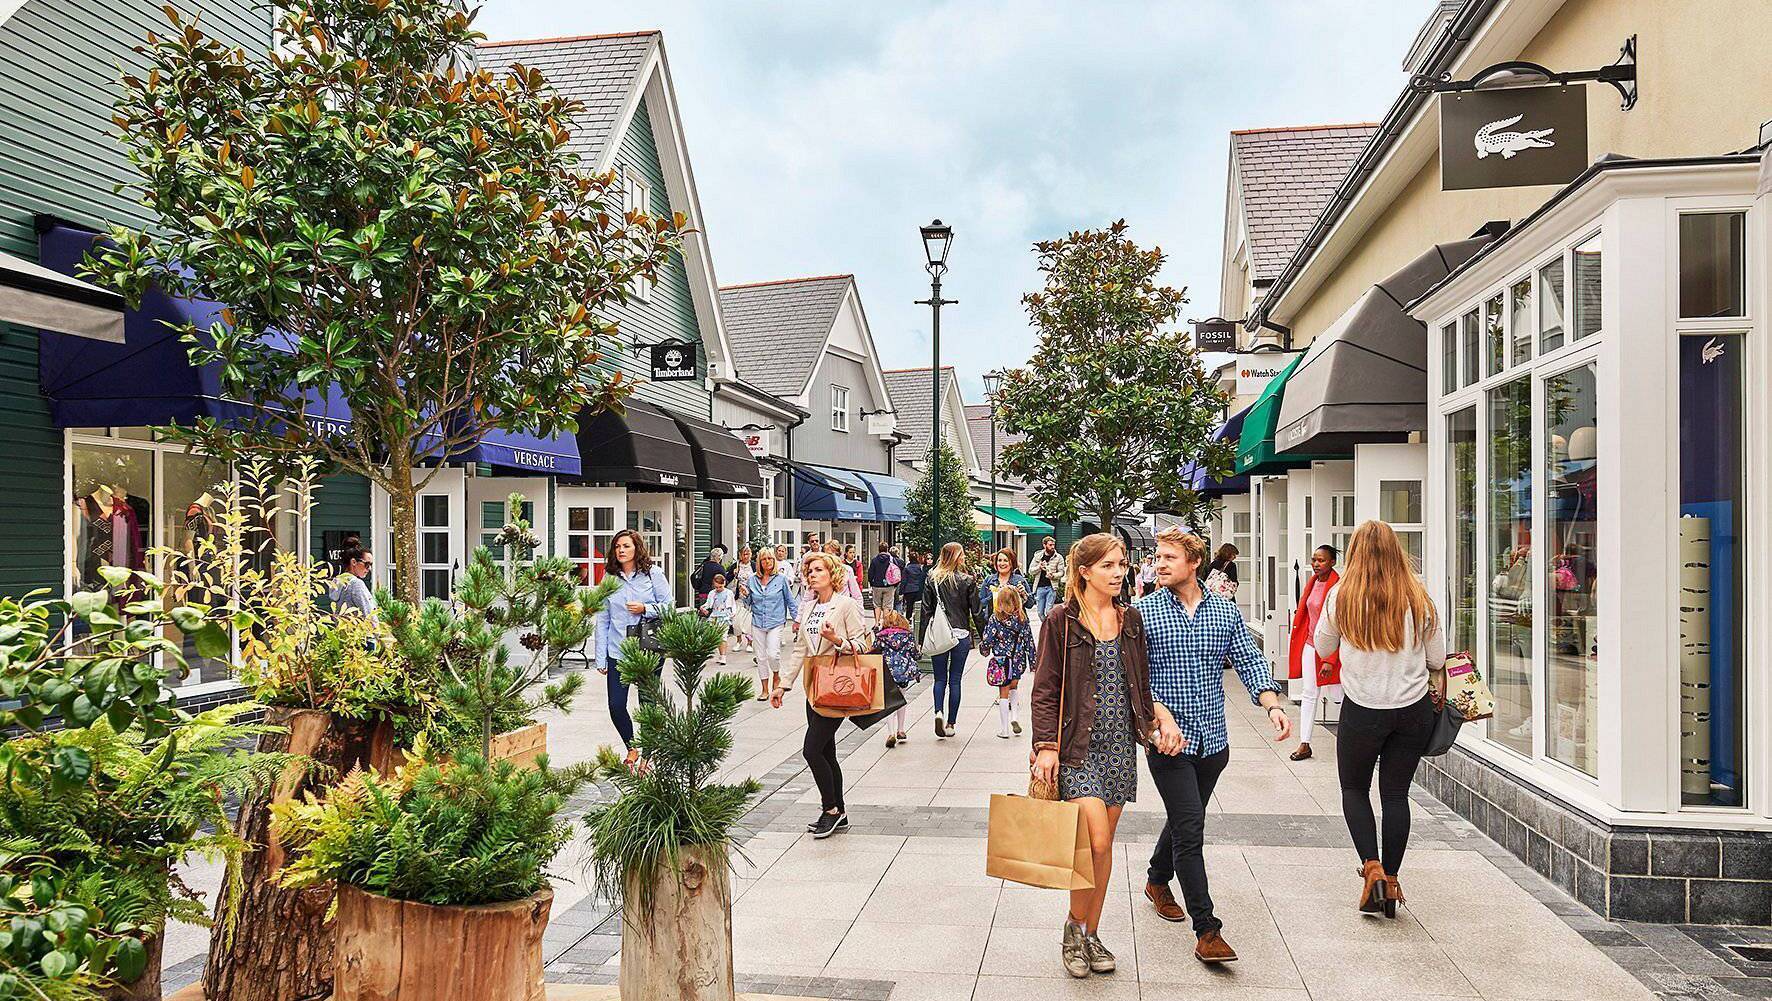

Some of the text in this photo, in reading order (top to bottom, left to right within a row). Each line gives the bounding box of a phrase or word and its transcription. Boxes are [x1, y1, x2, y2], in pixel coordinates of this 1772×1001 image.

[654, 367, 694, 377] Timberland
[1251, 369, 1269, 377] Watch
[514, 450, 555, 469] VERSACE
